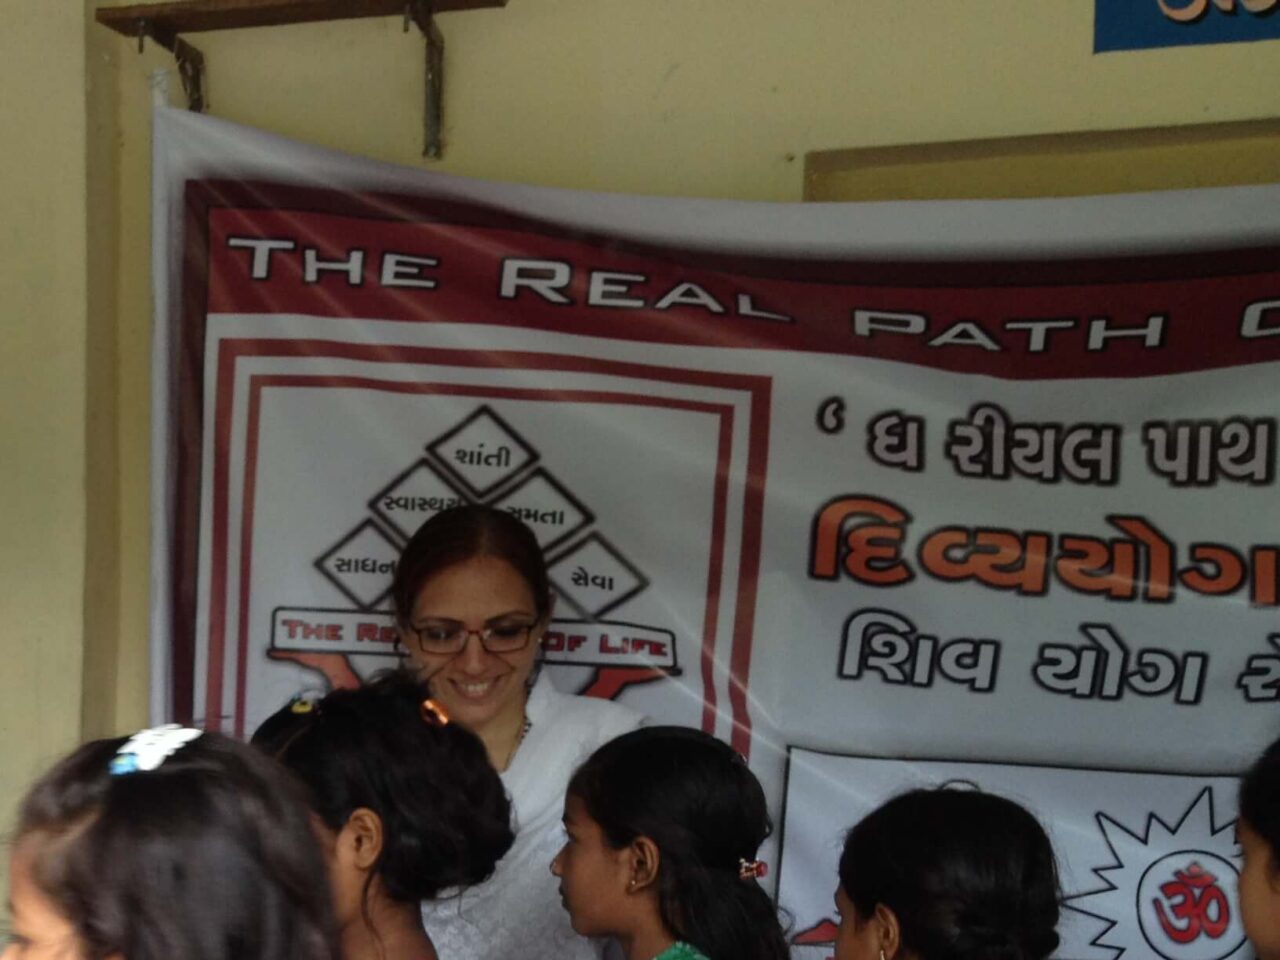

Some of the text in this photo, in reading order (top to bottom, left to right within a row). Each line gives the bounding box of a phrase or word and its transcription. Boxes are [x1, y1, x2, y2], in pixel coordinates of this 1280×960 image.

[853, 309, 1164, 352] PATH
[945, 402, 1120, 487] રીયલ
[837, 607, 1001, 693] શિવ
[1032, 623, 1208, 705] યોગ
